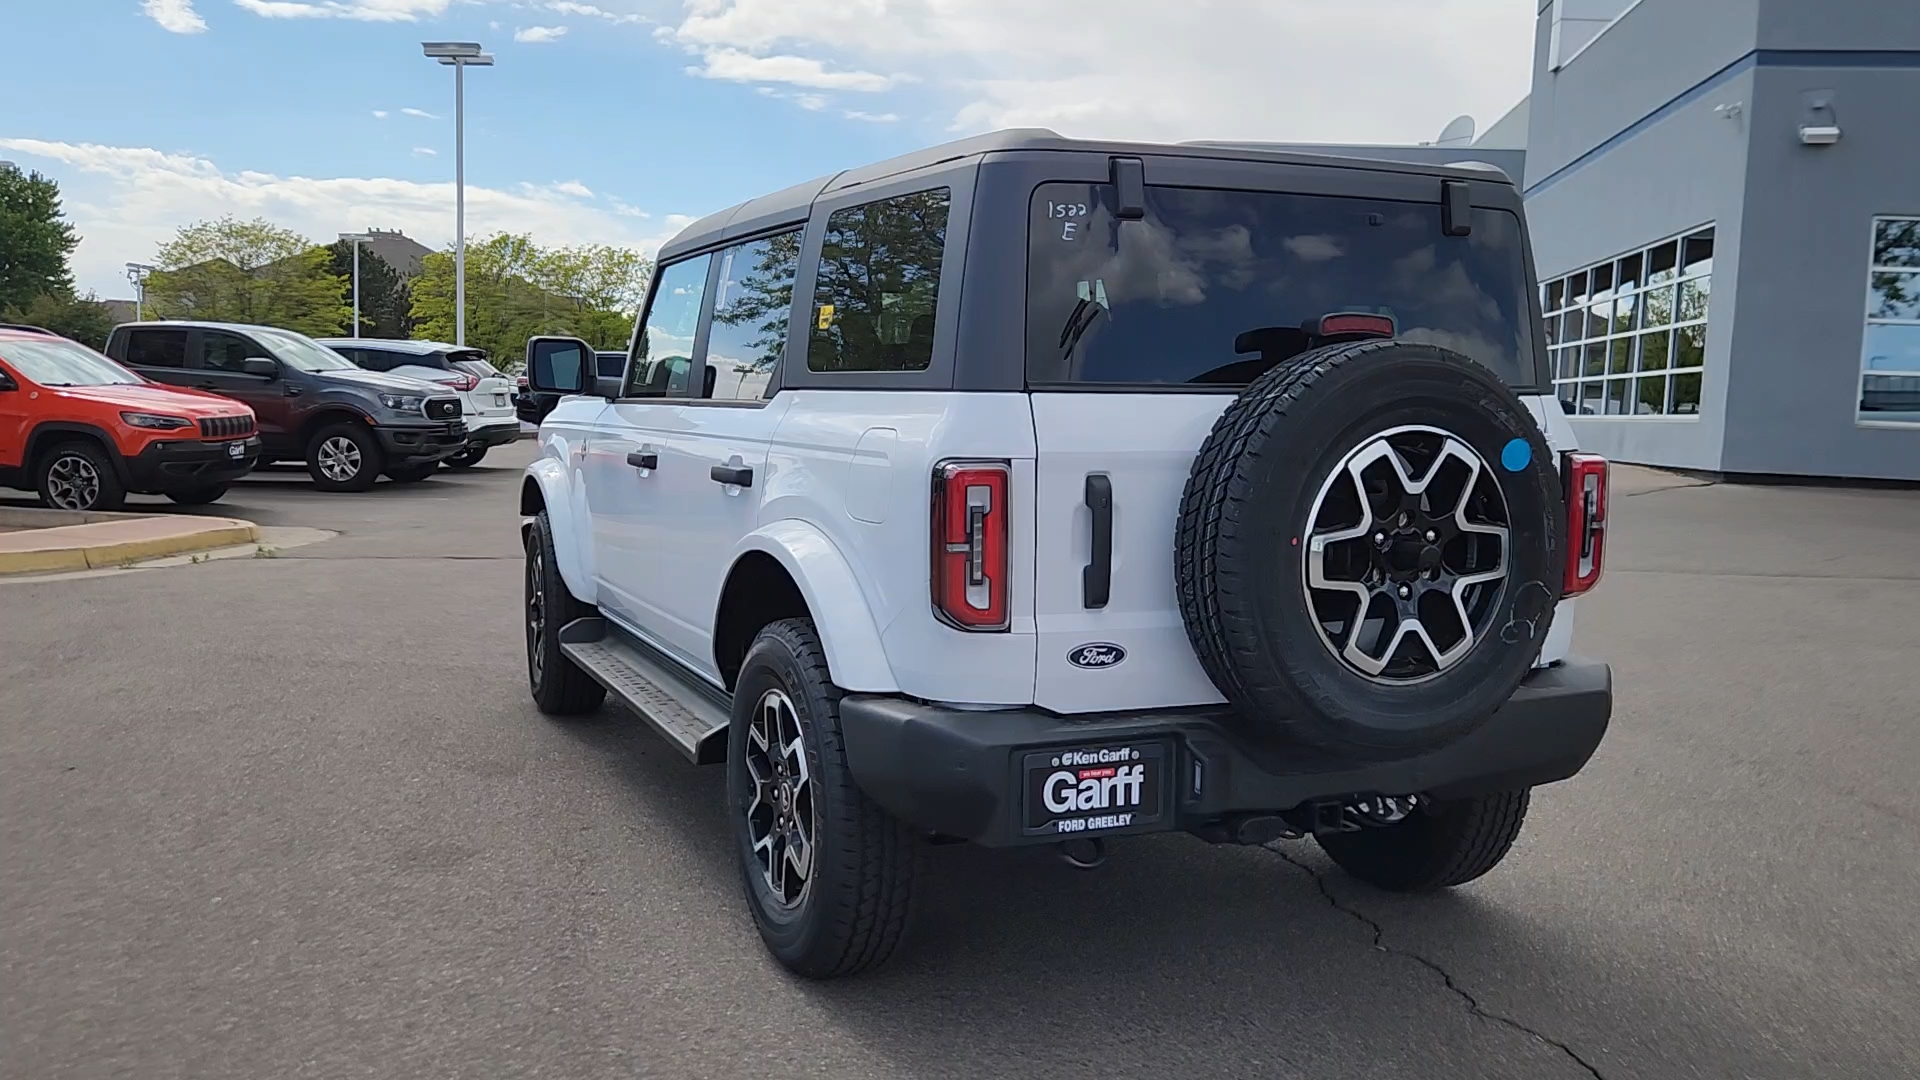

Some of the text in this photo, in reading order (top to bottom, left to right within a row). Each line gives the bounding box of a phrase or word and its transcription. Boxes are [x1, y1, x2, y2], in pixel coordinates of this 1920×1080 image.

[1061, 221, 1078, 241] E
[1079, 647, 1117, 665] Ford
[1073, 751, 1098, 766] Ken
[1099, 748, 1131, 763] Garff
[1043, 764, 1144, 814] Garff
[1058, 814, 1132, 833] FORD GREELEY
